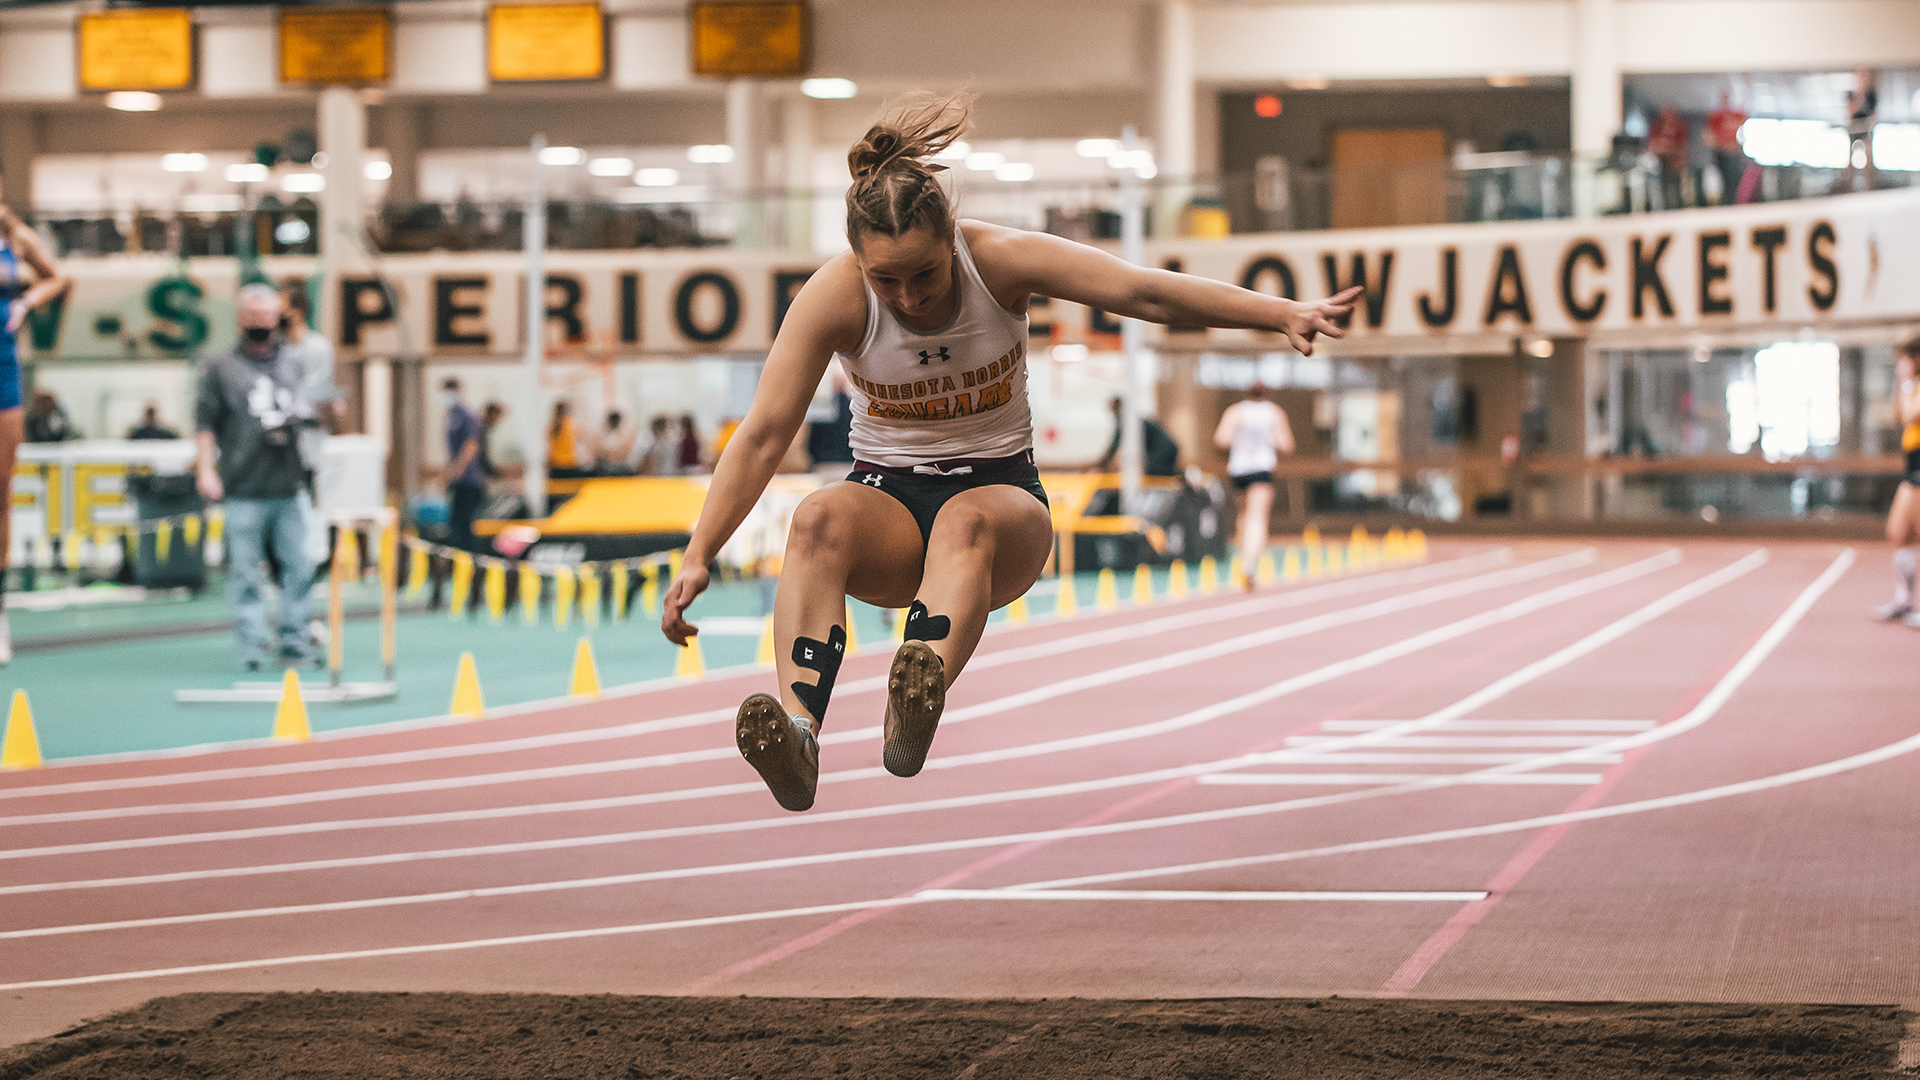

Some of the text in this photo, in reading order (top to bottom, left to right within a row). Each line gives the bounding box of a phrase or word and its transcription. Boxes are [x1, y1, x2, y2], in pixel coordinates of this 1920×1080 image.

[27, 220, 1841, 351] -SPERIO OWJACKETS
[910, 610, 921, 621] KT
[804, 646, 814, 660] KT
